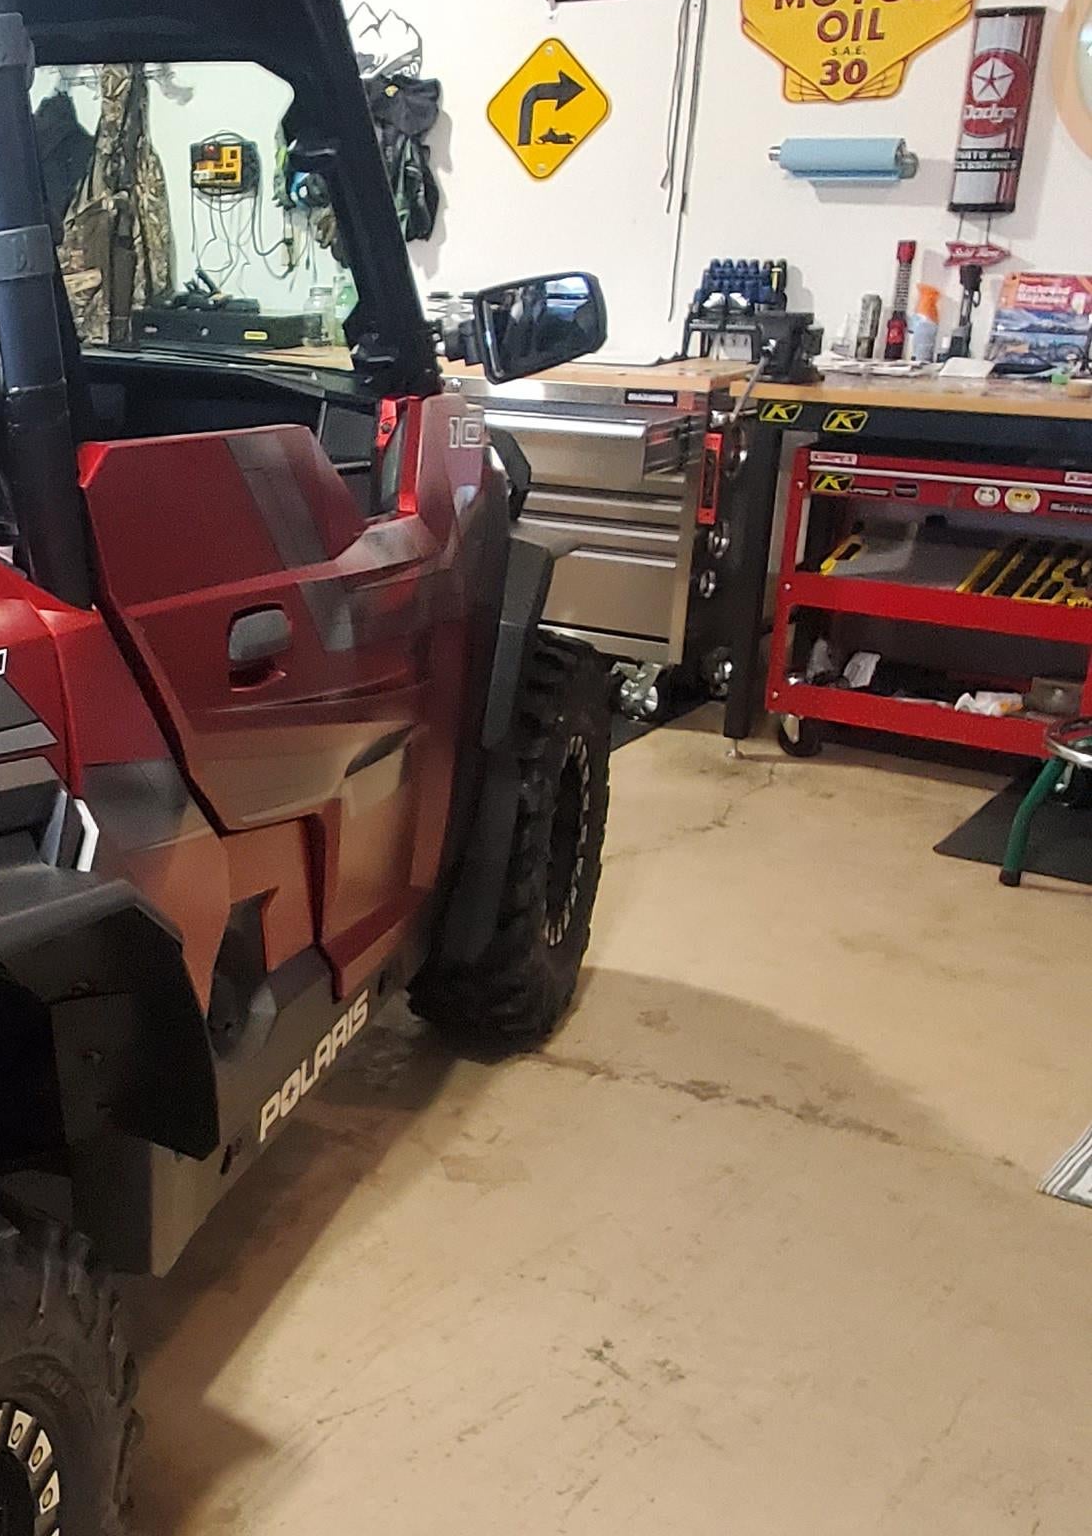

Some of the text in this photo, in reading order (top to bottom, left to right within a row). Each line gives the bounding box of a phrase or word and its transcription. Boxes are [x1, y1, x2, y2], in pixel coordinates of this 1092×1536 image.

[817, 8, 885, 42] OIL
[820, 58, 868, 86] 30
[963, 105, 1017, 123] Dodge
[259, 988, 369, 1143] POLARIS
